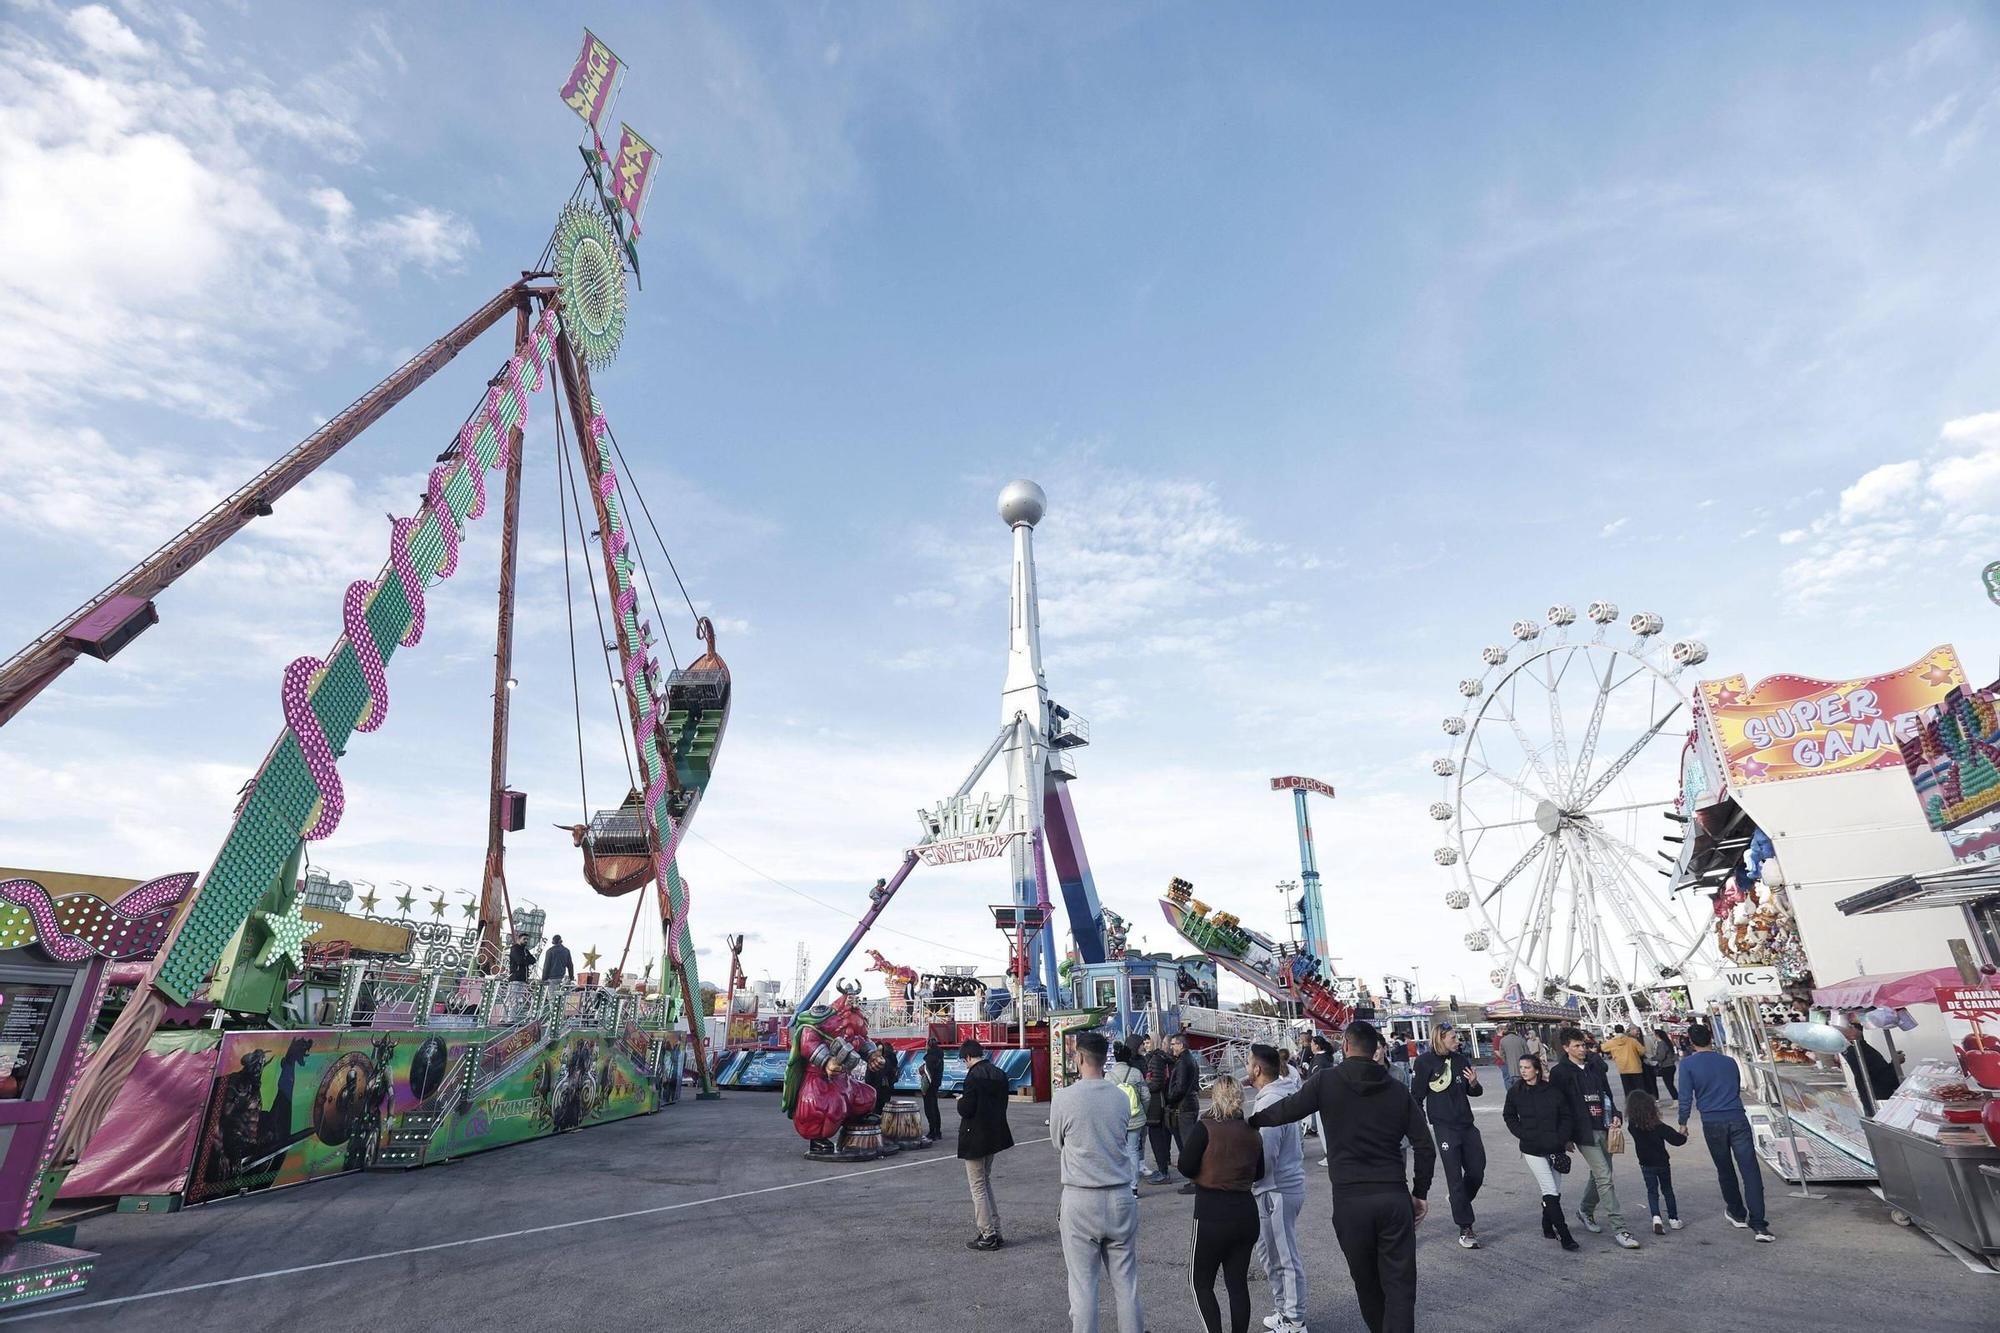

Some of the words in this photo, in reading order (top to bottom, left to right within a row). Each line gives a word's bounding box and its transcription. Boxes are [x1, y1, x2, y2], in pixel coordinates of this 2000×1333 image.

[1744, 689, 1881, 748] SUPER
[1291, 777, 1334, 798] CARCEL
[917, 792, 1013, 842] HIGH
[914, 833, 1014, 866] ENERGY
[1726, 972, 1756, 985] WC
[1947, 1001, 1962, 1010] DE
[486, 1097, 541, 1125] VIKINGO
